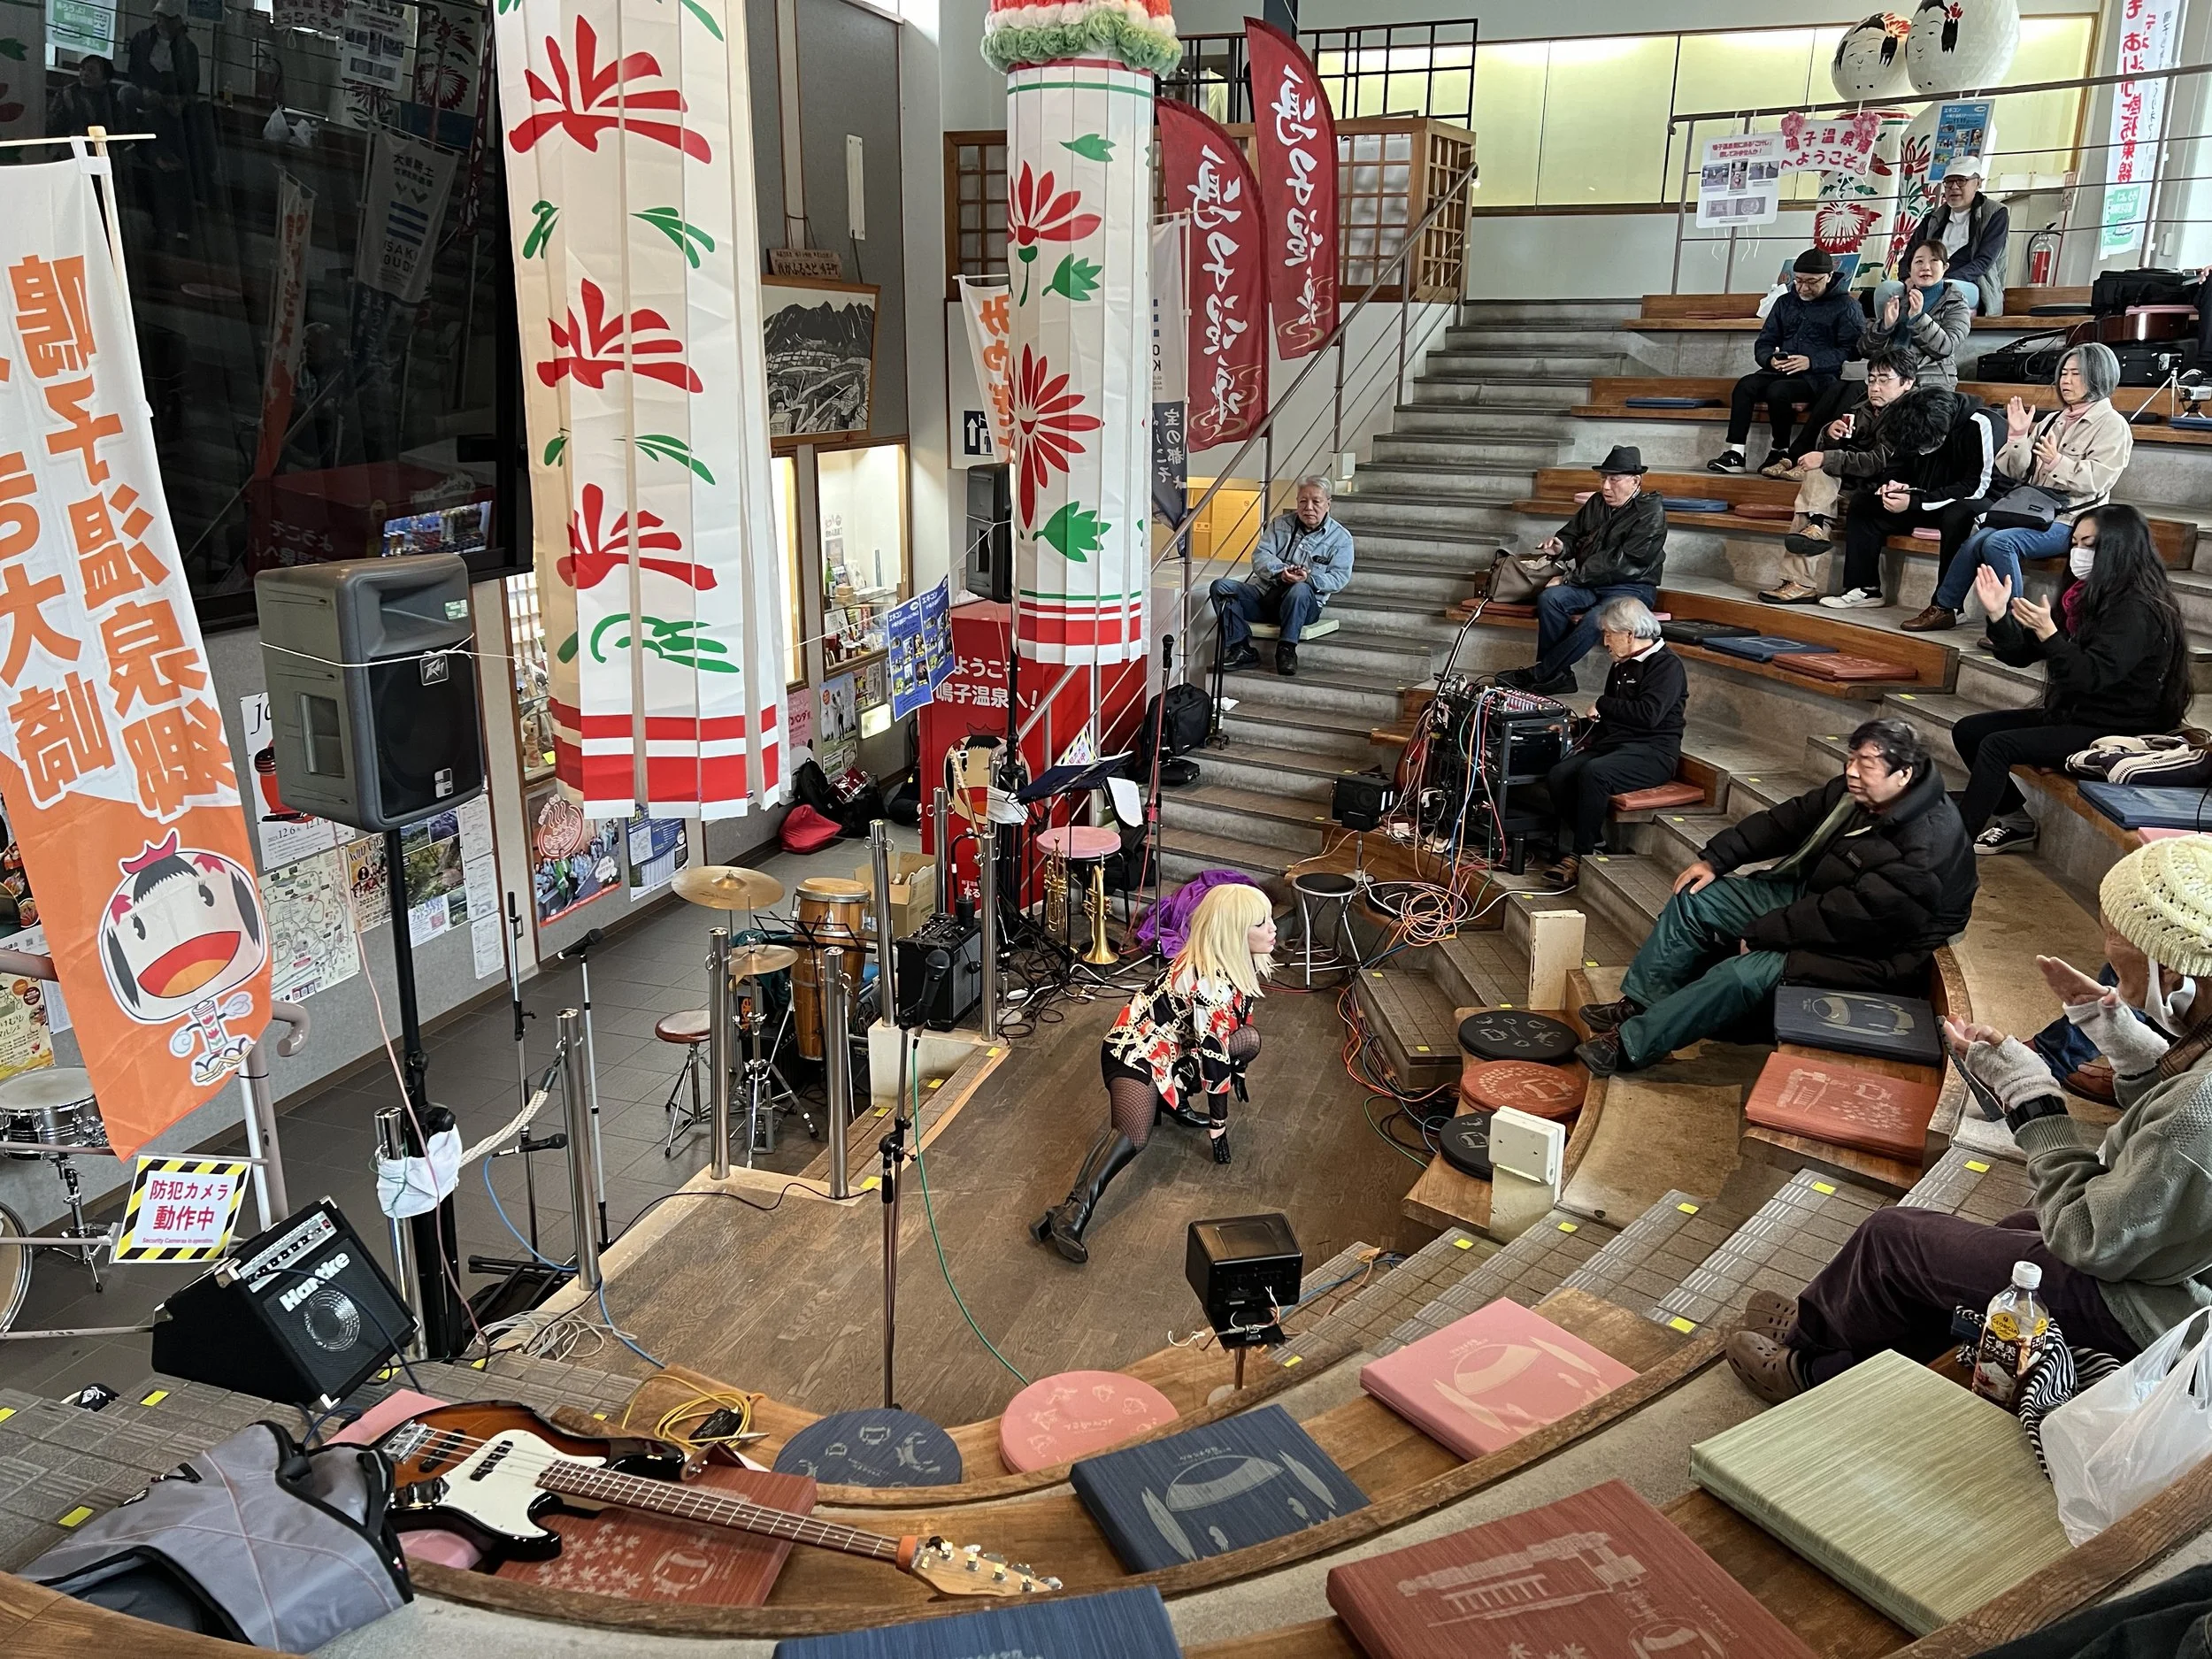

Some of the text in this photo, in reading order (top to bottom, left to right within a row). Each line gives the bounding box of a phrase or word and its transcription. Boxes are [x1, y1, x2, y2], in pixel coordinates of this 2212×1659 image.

[1781, 150, 1858, 169] へようこそ
[150, 1179, 228, 1201] 防犯カメラ
[153, 1204, 214, 1231] 動作中
[279, 1252, 350, 1312] Hartke
[1993, 1317, 2018, 1333] GEORGIA
